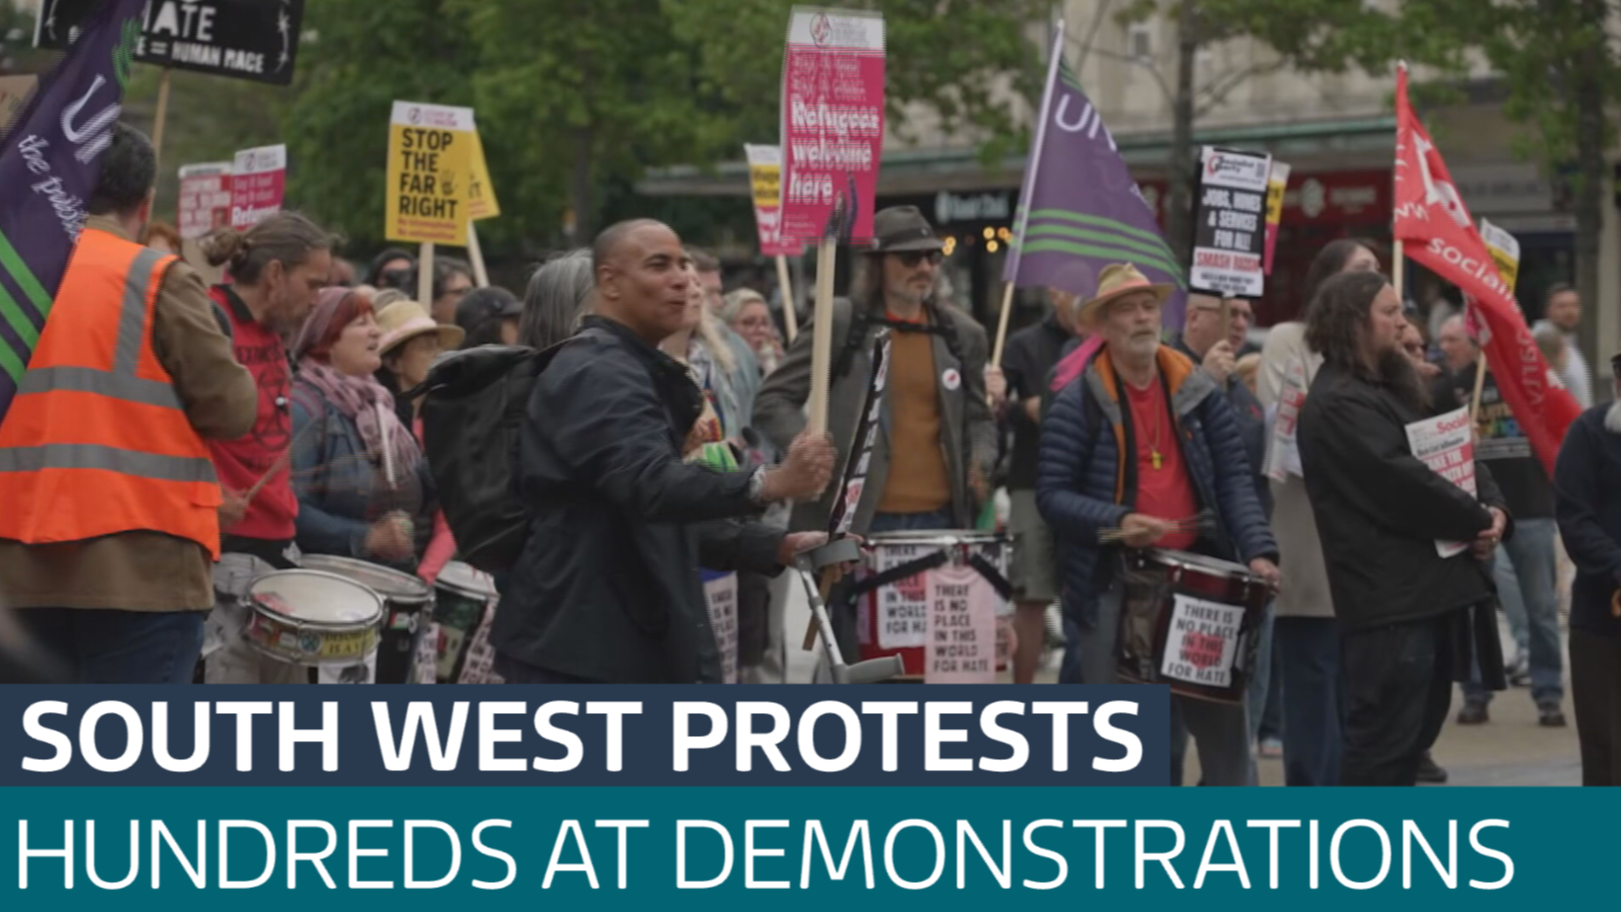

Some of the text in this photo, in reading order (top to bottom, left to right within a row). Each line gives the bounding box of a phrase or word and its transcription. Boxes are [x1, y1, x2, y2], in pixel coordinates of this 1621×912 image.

[172, 42, 221, 67] HUMAN
[402, 128, 453, 151] STOP
[401, 150, 439, 172] THE
[399, 173, 436, 195] FAR
[788, 165, 834, 205] here
[398, 195, 458, 219] RIGHT
[886, 592, 897, 602] IN
[935, 585, 970, 597] THERE
[934, 600, 968, 612] IS NO
[1184, 604, 1235, 624] THERE IS
[886, 622, 908, 634] FOR
[934, 615, 971, 627] PLACE
[1176, 618, 1235, 640] NO PLACE
[934, 630, 976, 642] IN THIS
[1181, 633, 1195, 647] IN
[935, 644, 978, 657] WORLD
[933, 659, 989, 672] FOR HATE
[1167, 662, 1227, 683] FOR HATE
